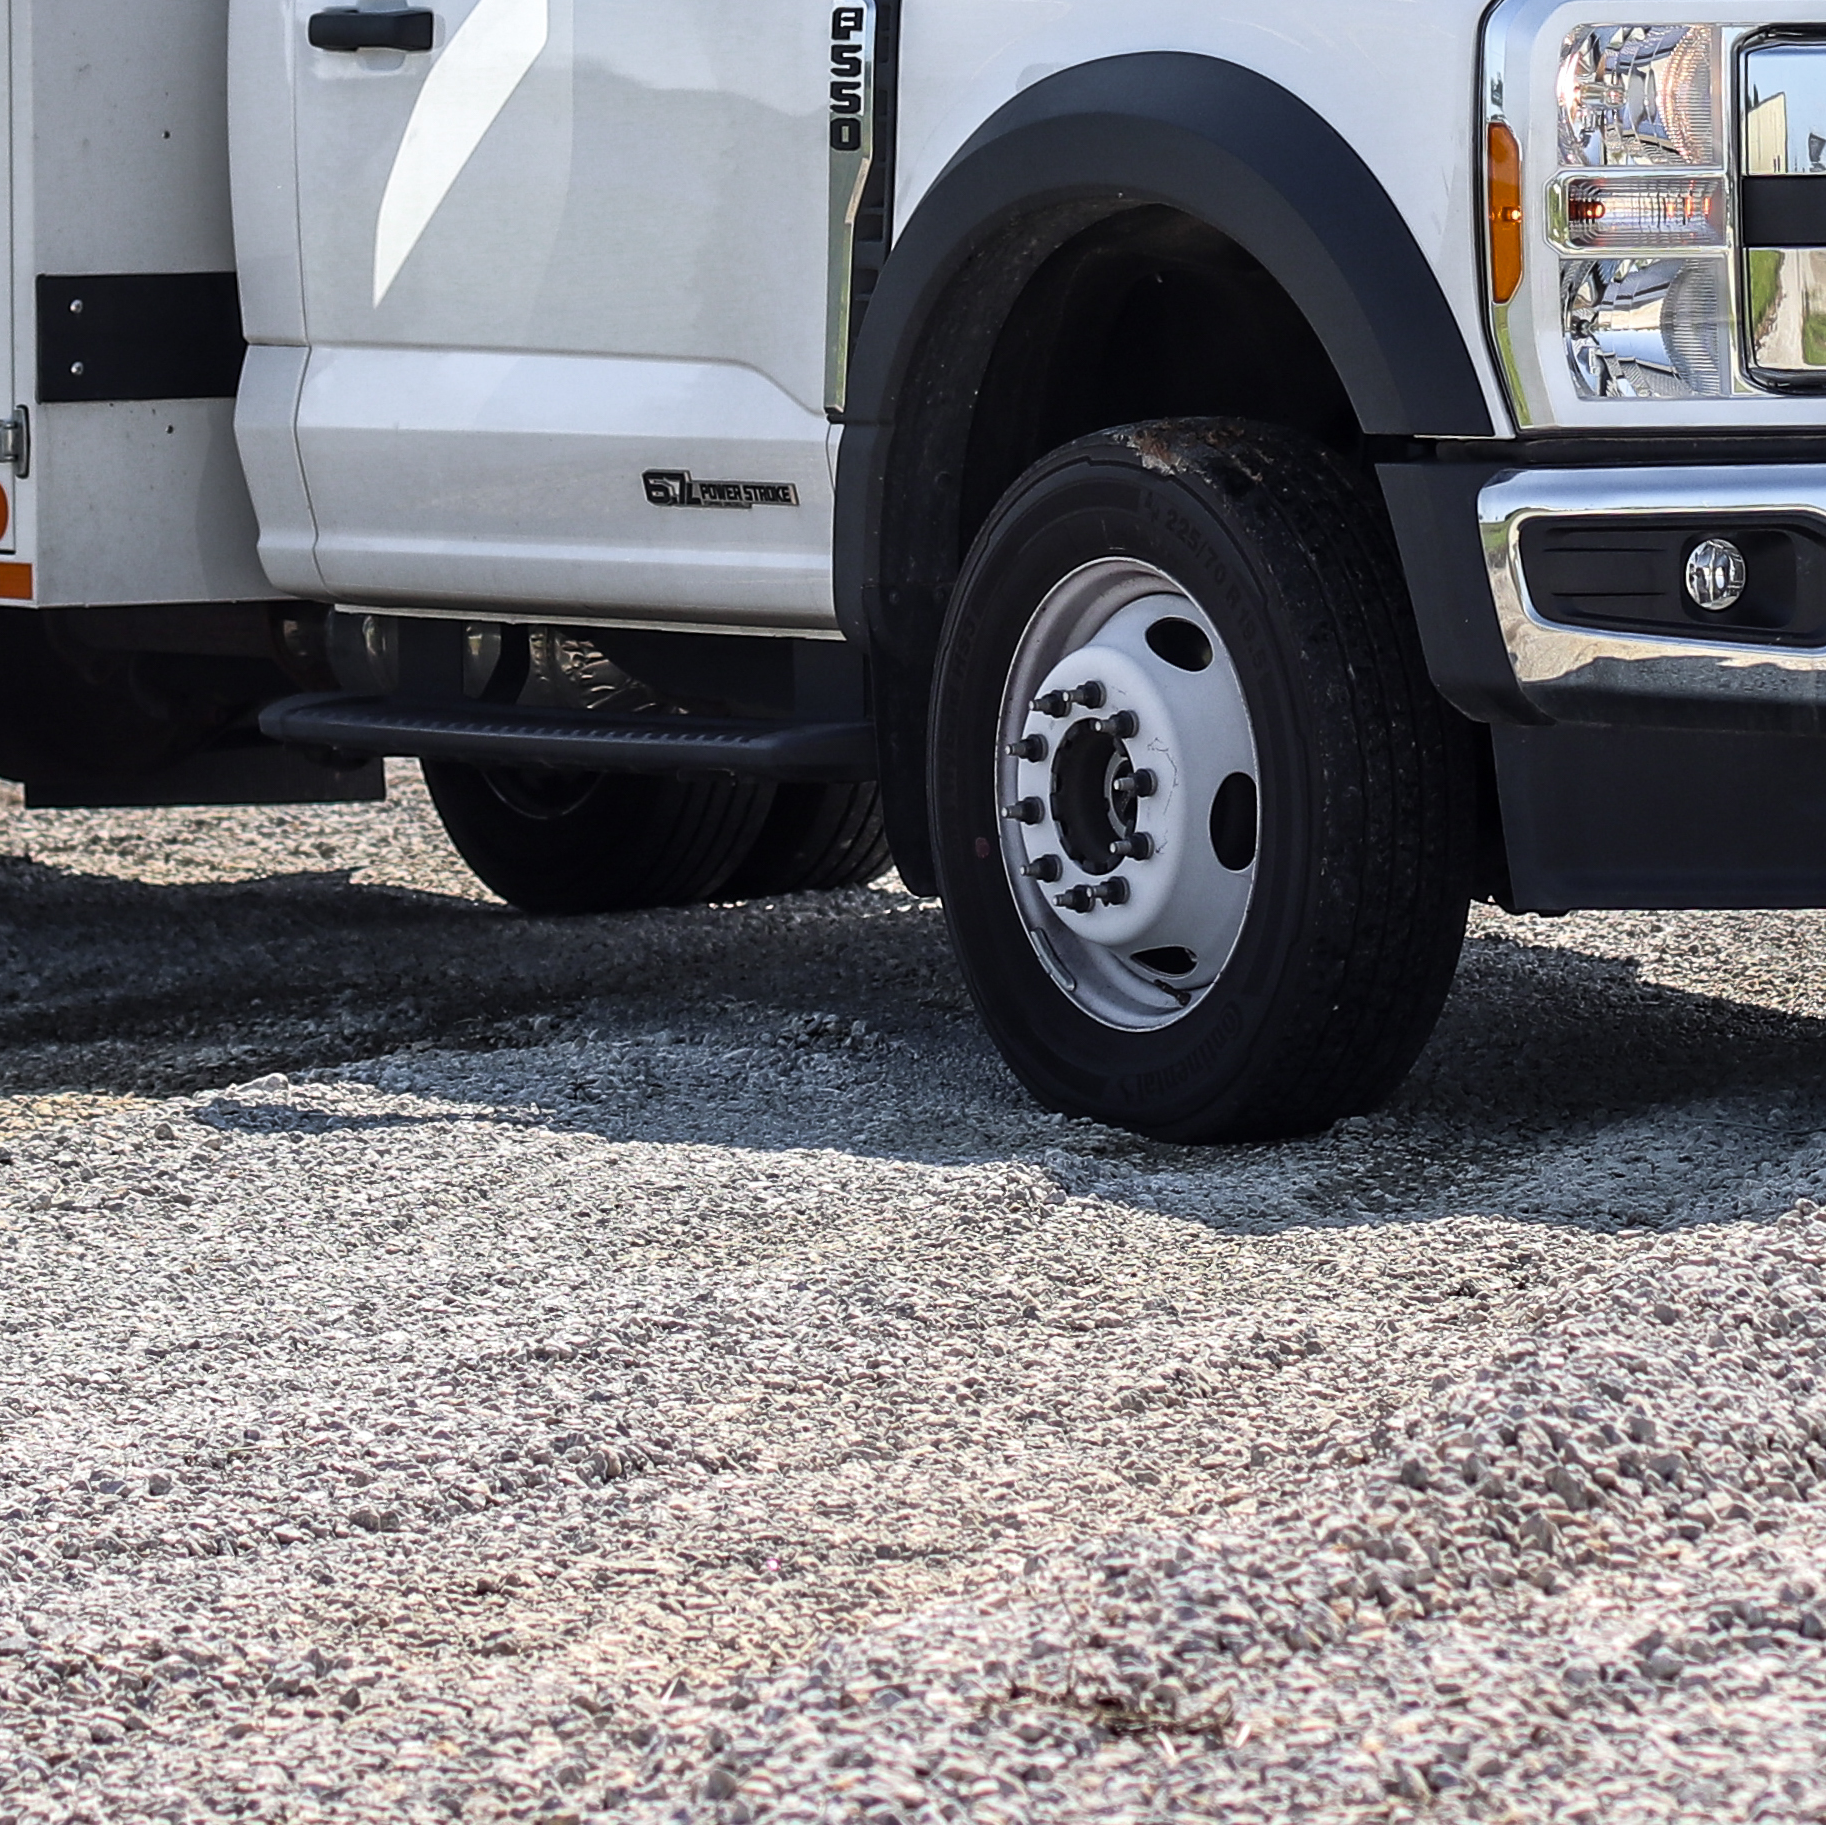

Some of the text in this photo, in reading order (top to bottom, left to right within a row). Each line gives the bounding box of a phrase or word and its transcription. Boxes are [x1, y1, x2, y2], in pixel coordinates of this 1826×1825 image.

[700, 483, 742, 502] POWER
[742, 485, 792, 503] STROKE
[1164, 507, 1227, 586] 225/70
[1136, 999, 1244, 1102] Continental
